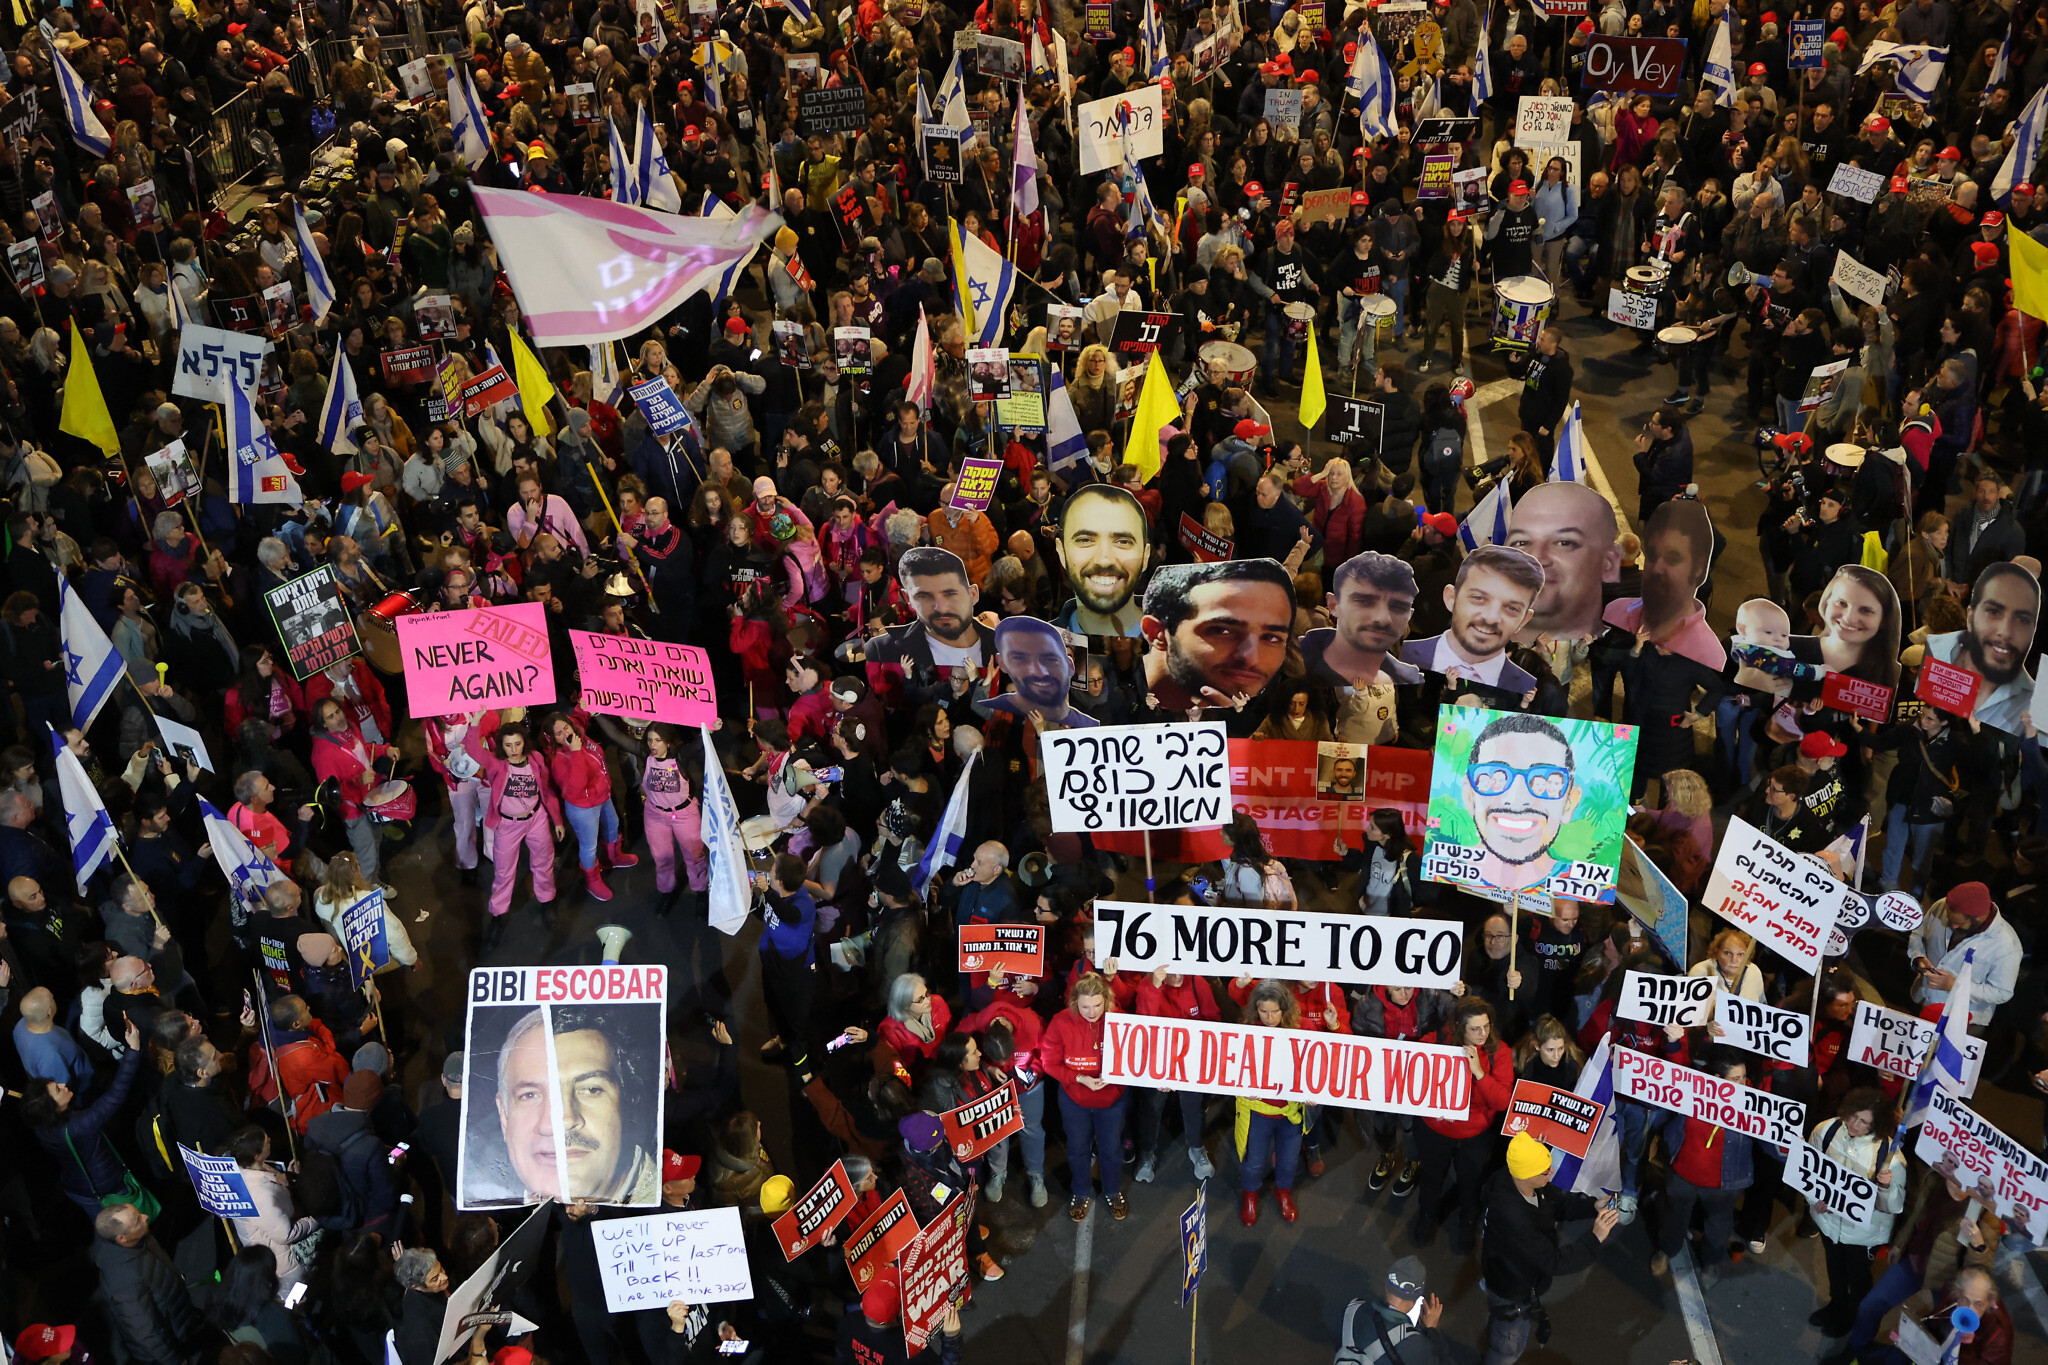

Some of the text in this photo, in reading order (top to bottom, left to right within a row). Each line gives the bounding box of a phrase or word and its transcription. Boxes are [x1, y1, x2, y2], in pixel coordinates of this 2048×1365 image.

[1545, 1, 1587, 12] חקירה
[1586, 43, 1676, 89] Oy Vey
[1268, 98, 1298, 107] TRUMP
[1269, 115, 1297, 123] TRUST
[1423, 171, 1449, 182] מלאה
[1426, 161, 1451, 171] עסקה
[1832, 178, 1877, 201] HOSTAGES
[1276, 279, 1296, 290] Life
[1138, 322, 1160, 343] כל
[1146, 314, 1169, 328] קודם
[390, 357, 431, 372] להיות אנחנו
[480, 372, 505, 390] דרושה:
[646, 394, 663, 403] בעד
[651, 406, 675, 420] חקירה
[960, 478, 993, 491] מלאה
[964, 466, 997, 478] עסקה
[271, 570, 330, 607] היום ראיתם
[291, 590, 321, 613] אותם
[290, 622, 354, 662] עכשיו הביתה
[466, 610, 551, 661] FAILED
[305, 648, 335, 673] כולם!
[415, 640, 496, 671] NEVER
[588, 635, 700, 665] הם עוברים
[596, 654, 646, 674] ואתה
[448, 665, 540, 703] AGAIN?
[637, 678, 714, 703] באמריקה
[1850, 681, 1890, 698] עדיין
[584, 688, 656, 714] בחופשה
[1051, 728, 1225, 766] ביבי שחרר
[1057, 763, 1154, 800] כולם
[1165, 763, 1223, 790] את
[1434, 843, 1486, 862] עכשיו
[1575, 863, 1609, 882] אור
[1751, 839, 1833, 895] הם חזרו
[1546, 878, 1597, 897] חזר!
[1733, 855, 1818, 909] מהגיהנום
[1730, 878, 1779, 915] מבלה
[1883, 895, 1922, 921] עזיבה
[345, 906, 383, 938] חופשיים
[1718, 896, 1757, 925] מלון
[996, 928, 1039, 940] לא נשאיר
[1781, 910, 1820, 938] והוא
[261, 944, 287, 960] HOME!
[964, 941, 1037, 954] אף אחד.ת מאחור
[1097, 909, 1462, 977] 76 MORE TO GO
[1765, 921, 1817, 958] בחדרי
[472, 967, 664, 1002] BIBI ESCOBAR
[1637, 975, 1713, 1002] סליחה
[1727, 999, 1803, 1039] סליחה
[1107, 1021, 1472, 1112] YOUR DEAL, YOUR WORD
[1618, 1050, 1803, 1128] סליחה שהחיים שלכם
[1630, 1077, 1683, 1108] שלהם
[959, 1087, 1010, 1125] לחופש
[1514, 1100, 1544, 1118] מאחור
[1551, 1093, 1596, 1118] לא נשאיר
[1576, 1119, 1590, 1133] אף
[1932, 1092, 2026, 1168] התמונות האלה
[200, 1171, 226, 1184] בעד
[201, 1160, 235, 1172] אנחנו
[1802, 1145, 1872, 1201] סליחה
[200, 1181, 231, 1193] ועדת
[200, 1189, 240, 1203] חקירה
[795, 1176, 836, 1221] מדינה
[800, 1187, 843, 1236] חטופה
[601, 1220, 710, 1242] We'll never
[850, 1201, 906, 1263] דרושה: תקווה
[905, 1258, 934, 1291] END
[934, 1226, 964, 1259] THIS
[907, 1257, 965, 1323] WAR
